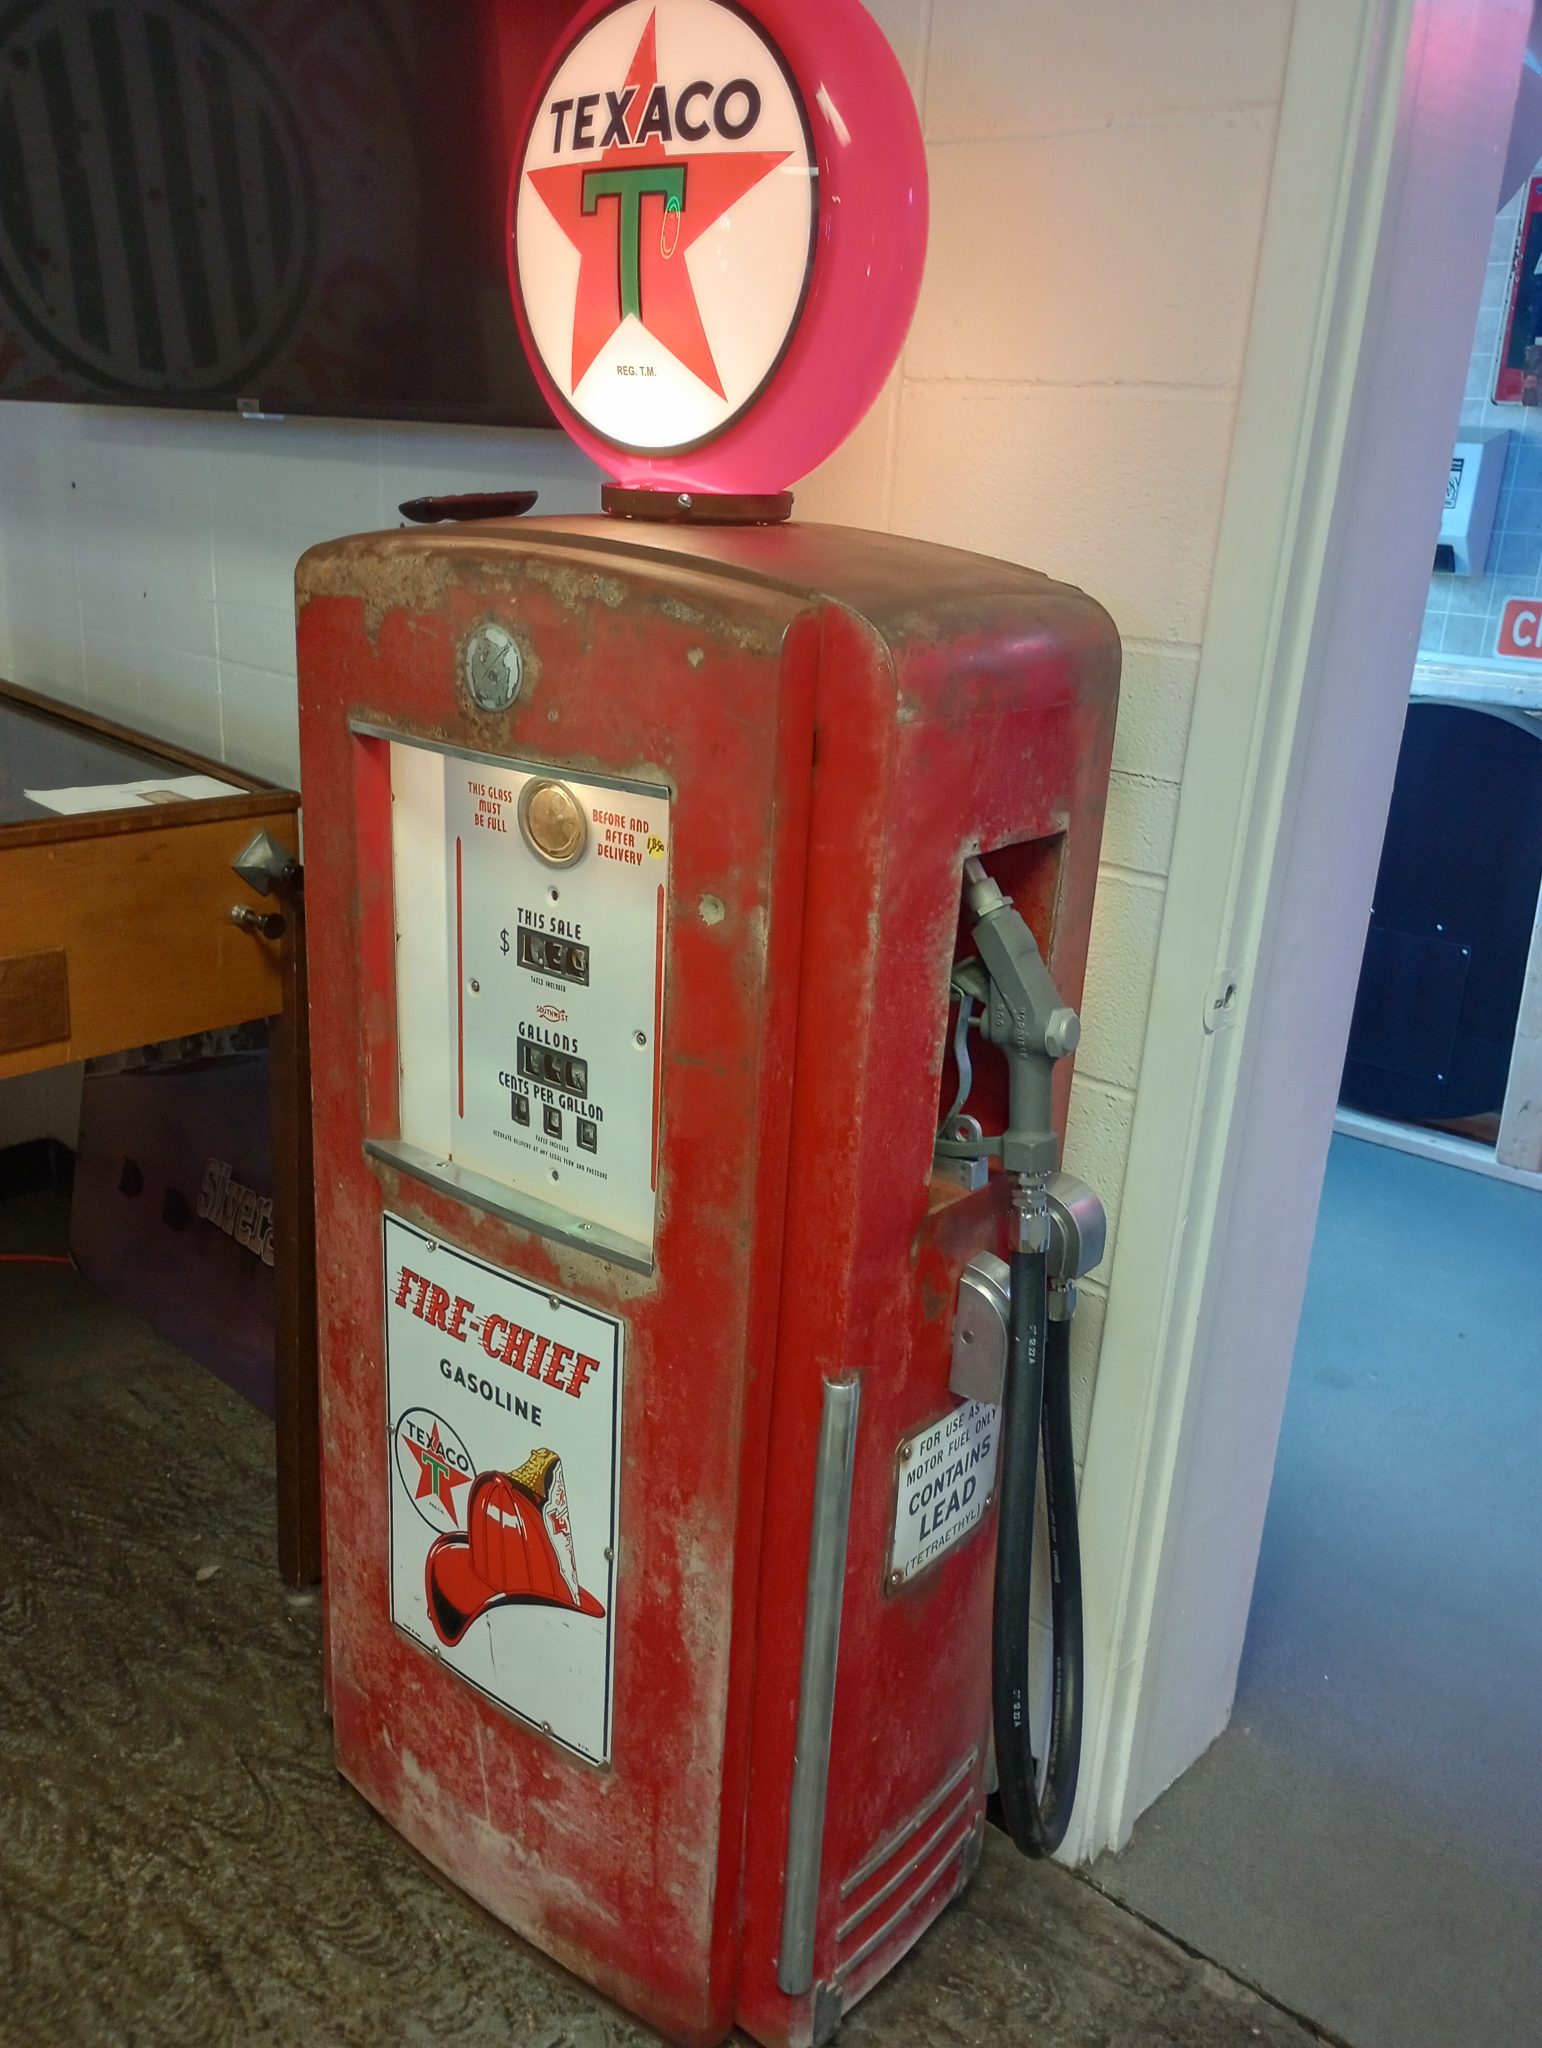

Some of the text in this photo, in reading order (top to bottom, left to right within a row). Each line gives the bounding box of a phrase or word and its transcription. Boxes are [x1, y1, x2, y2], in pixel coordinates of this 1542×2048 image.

[550, 78, 761, 154] TEXACO
[580, 162, 688, 323] T
[617, 365, 657, 377] REG. T.M.
[468, 781, 512, 803] THIS GLASS
[479, 799, 501, 815] MUST
[475, 813, 507, 833] BE FULL
[592, 808, 649, 833] BEFORE AND
[605, 829, 635, 848] AFTER
[597, 843, 643, 866] DELIVERY
[499, 928, 510, 956] $
[517, 907, 582, 940] THIS SALE
[536, 1004, 569, 1022] SOUTHWEST
[518, 1021, 578, 1053] GALLONS
[498, 1071, 529, 1095] CENTS
[533, 1084, 554, 1105] PER
[558, 1094, 604, 1121] GALLON
[391, 1265, 601, 1399] FIRE-CHIEF
[439, 1358, 542, 1427] GASOLINE
[406, 1419, 469, 1472] TEXACO
[906, 1408, 997, 1488] MOTOR FUEL ONLY
[919, 1402, 980, 1457] FOR USE AS
[908, 1434, 992, 1517] CONTAINS
[919, 1475, 977, 1542] LEAD
[905, 1503, 981, 1577] (TETRAETHYL)
